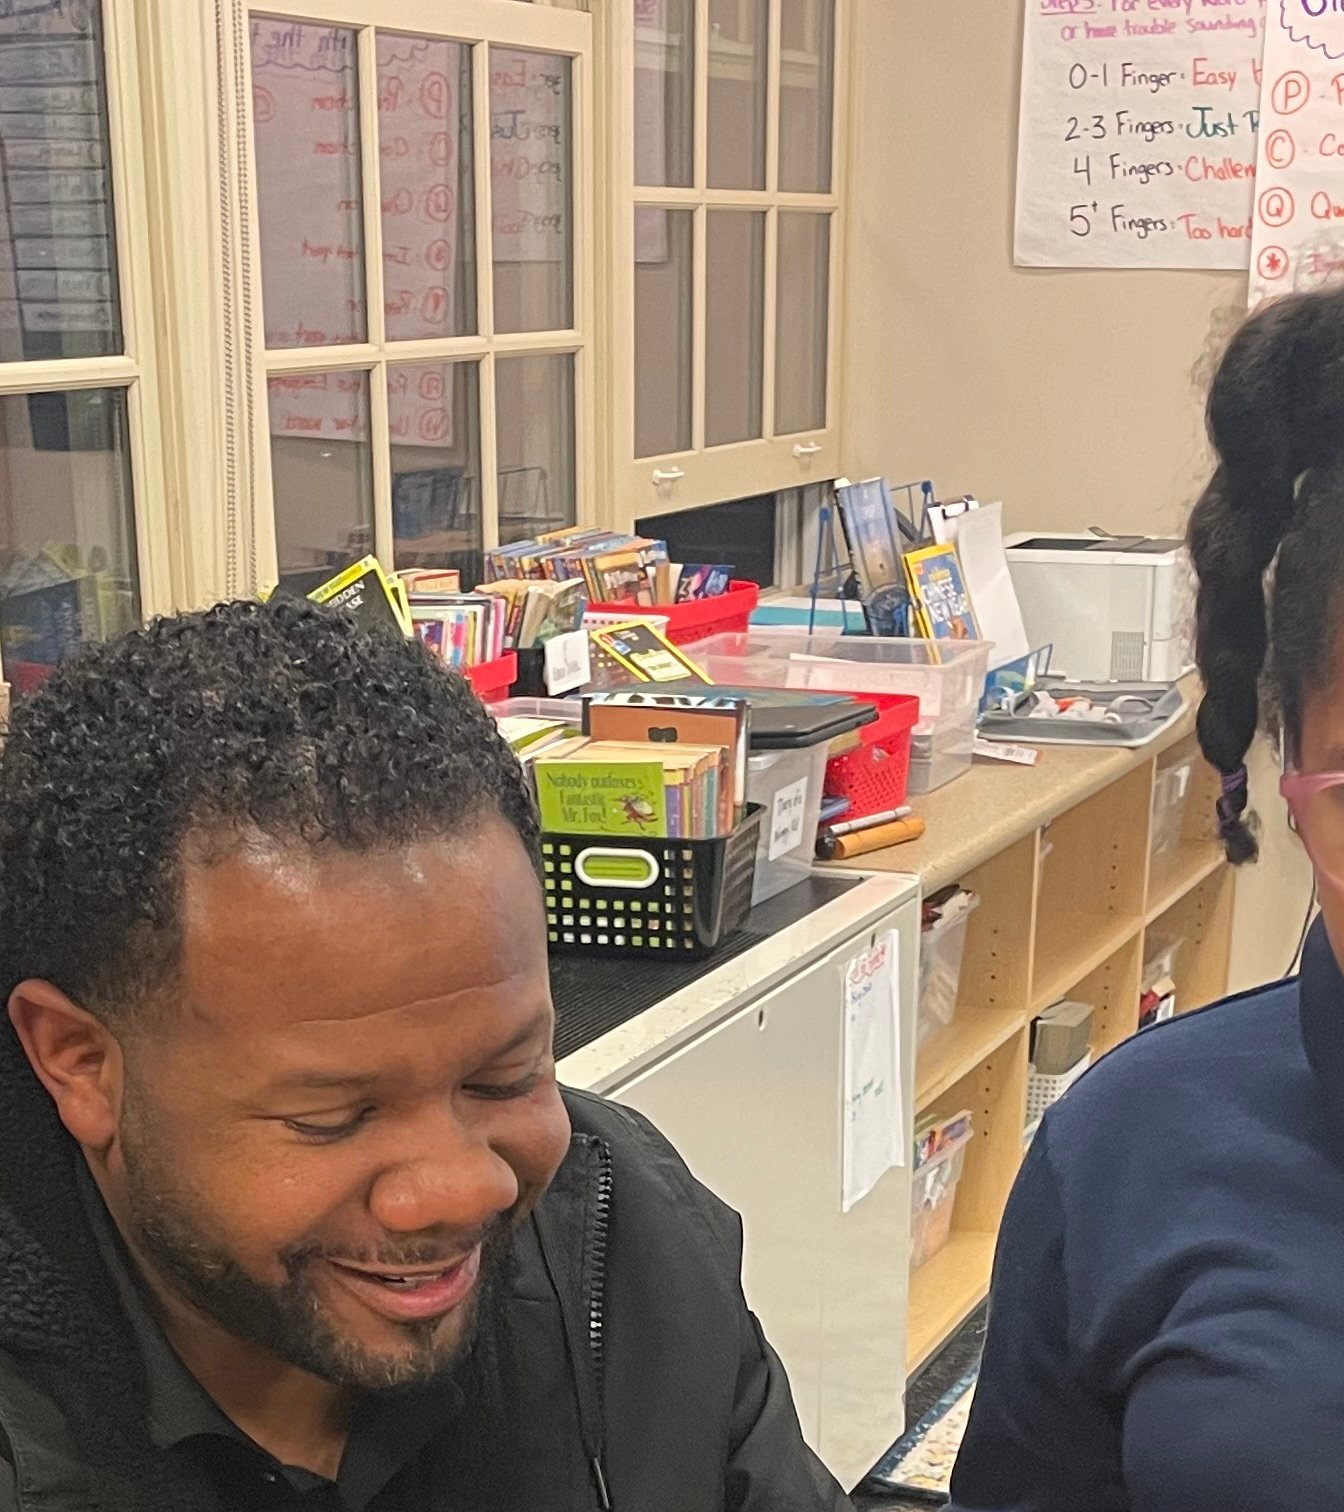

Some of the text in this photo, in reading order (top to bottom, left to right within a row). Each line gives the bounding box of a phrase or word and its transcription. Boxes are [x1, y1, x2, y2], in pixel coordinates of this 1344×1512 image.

[1061, 24, 1077, 41] or
[1123, 19, 1177, 38] trouble
[1069, 62, 1107, 89] 0-1
[1192, 57, 1238, 91] Easy
[1064, 114, 1106, 141] 2-3
[1186, 106, 1239, 139] Just
[1073, 155, 1091, 186] 4
[1177, 213, 1213, 240] Too
